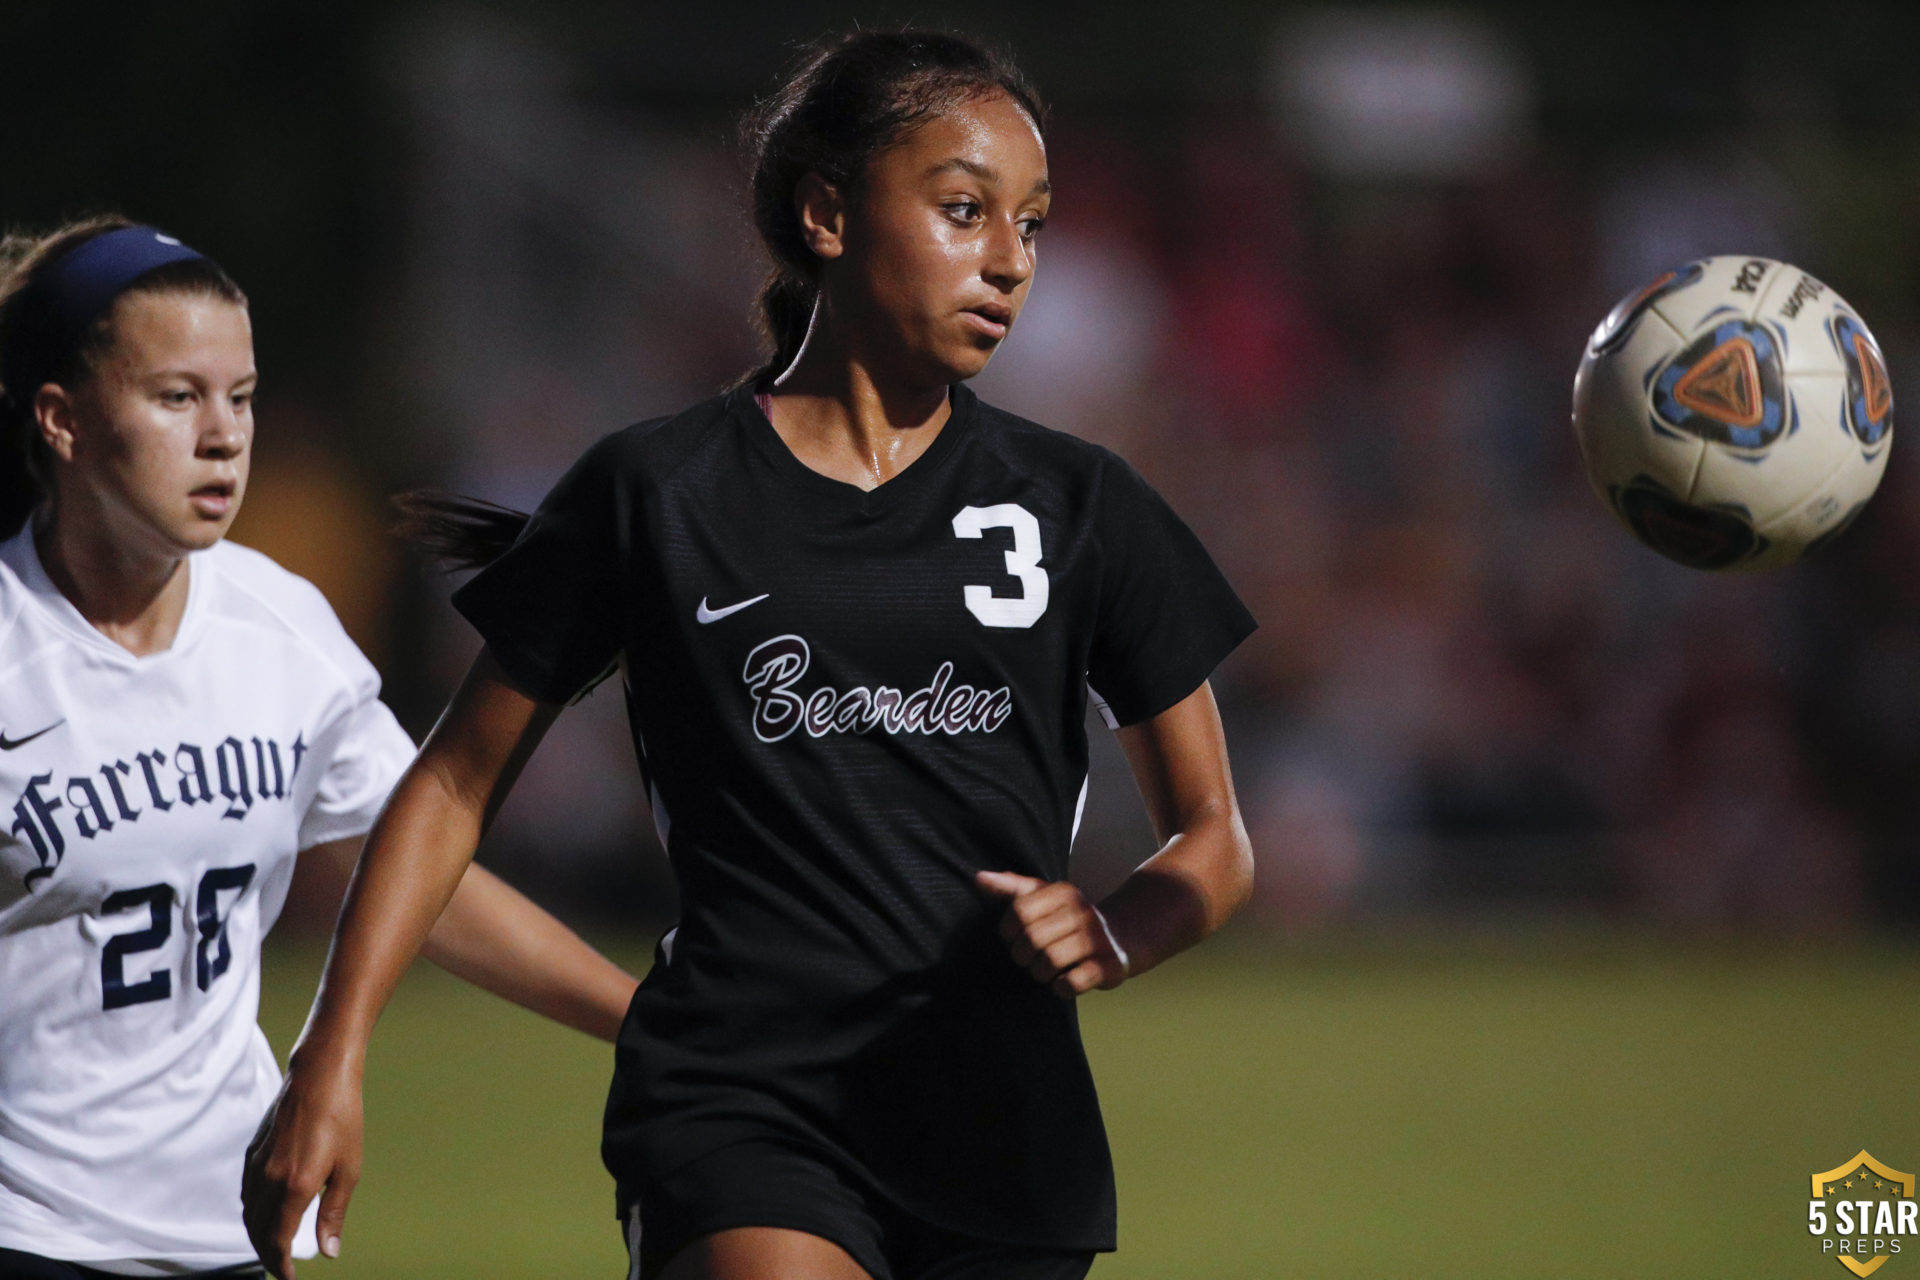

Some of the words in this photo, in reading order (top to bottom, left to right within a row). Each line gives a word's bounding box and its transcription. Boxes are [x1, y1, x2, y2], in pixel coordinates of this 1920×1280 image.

[951, 503, 1050, 629] 3
[743, 633, 1012, 743] Bearden
[11, 729, 308, 894] Farragut
[101, 862, 257, 1012] 28
